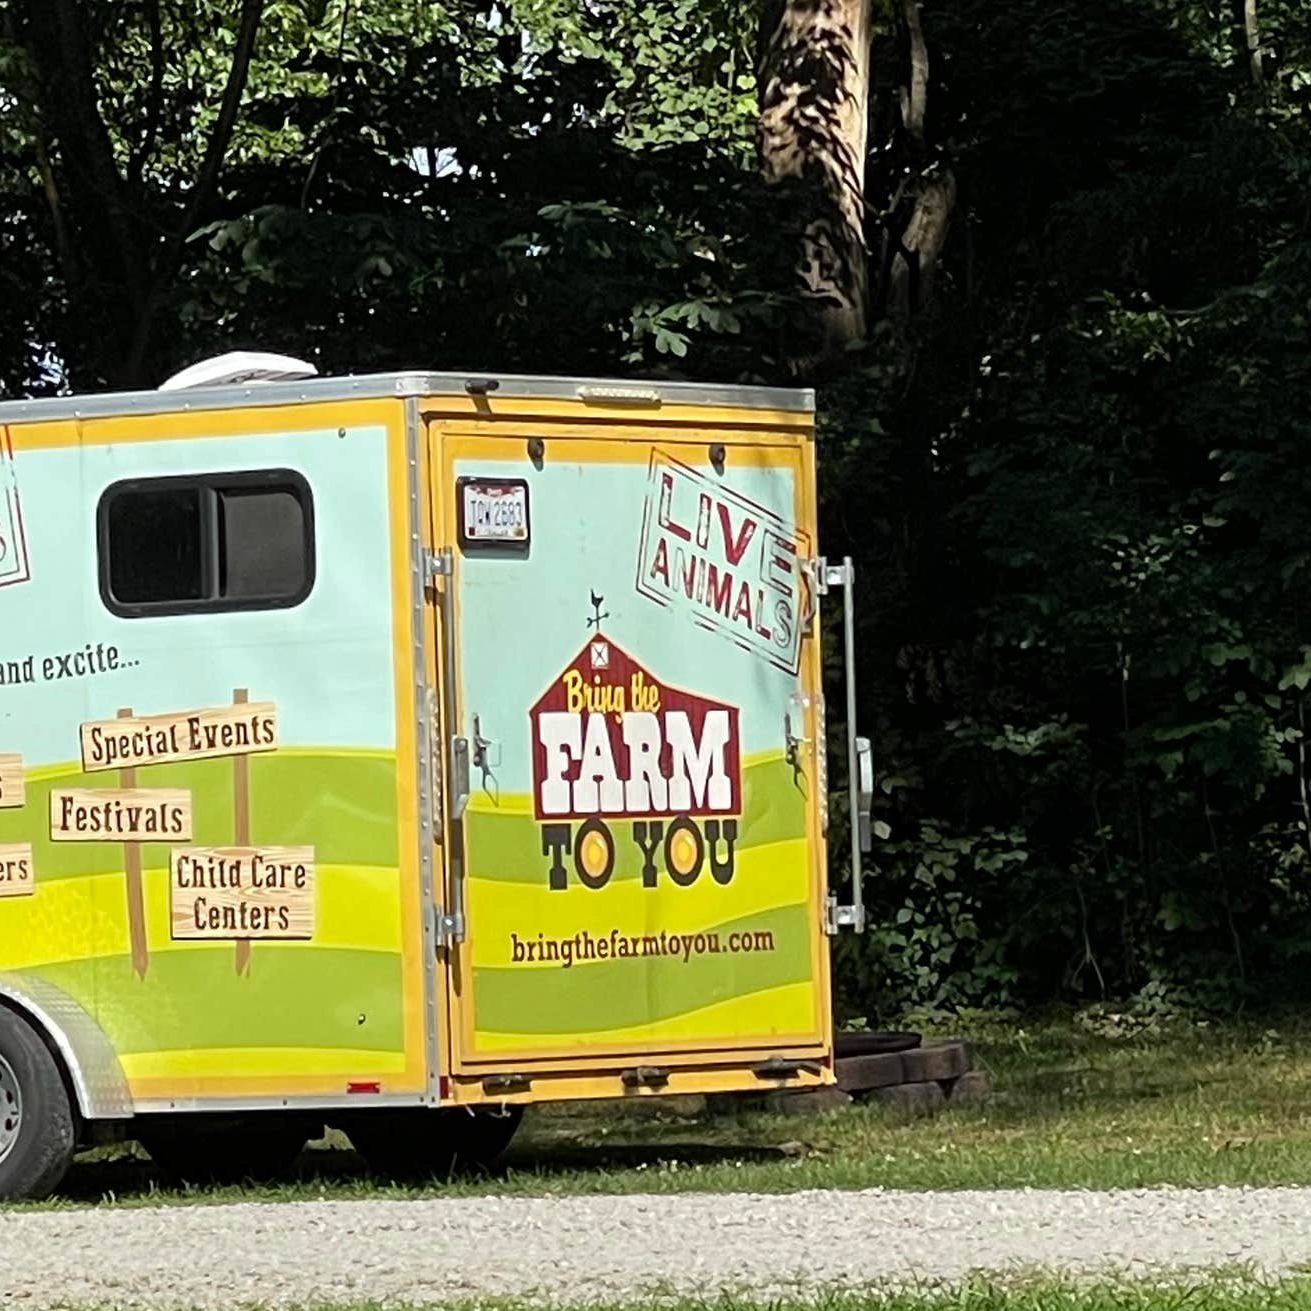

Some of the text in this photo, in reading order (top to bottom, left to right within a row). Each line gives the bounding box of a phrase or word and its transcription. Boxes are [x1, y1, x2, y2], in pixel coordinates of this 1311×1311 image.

[658, 472, 797, 598] LIVE
[650, 537, 792, 649] ANIMALS
[43, 642, 139, 680] excite...
[563, 669, 661, 724] Bring the
[91, 714, 274, 764] Special Events
[538, 710, 732, 815] FARM
[60, 796, 183, 833] Festivals
[177, 855, 306, 888] Child Care
[541, 814, 738, 891] TO YOU
[193, 897, 290, 930] Centers
[510, 929, 775, 968] bringthefarmtoyou.com
